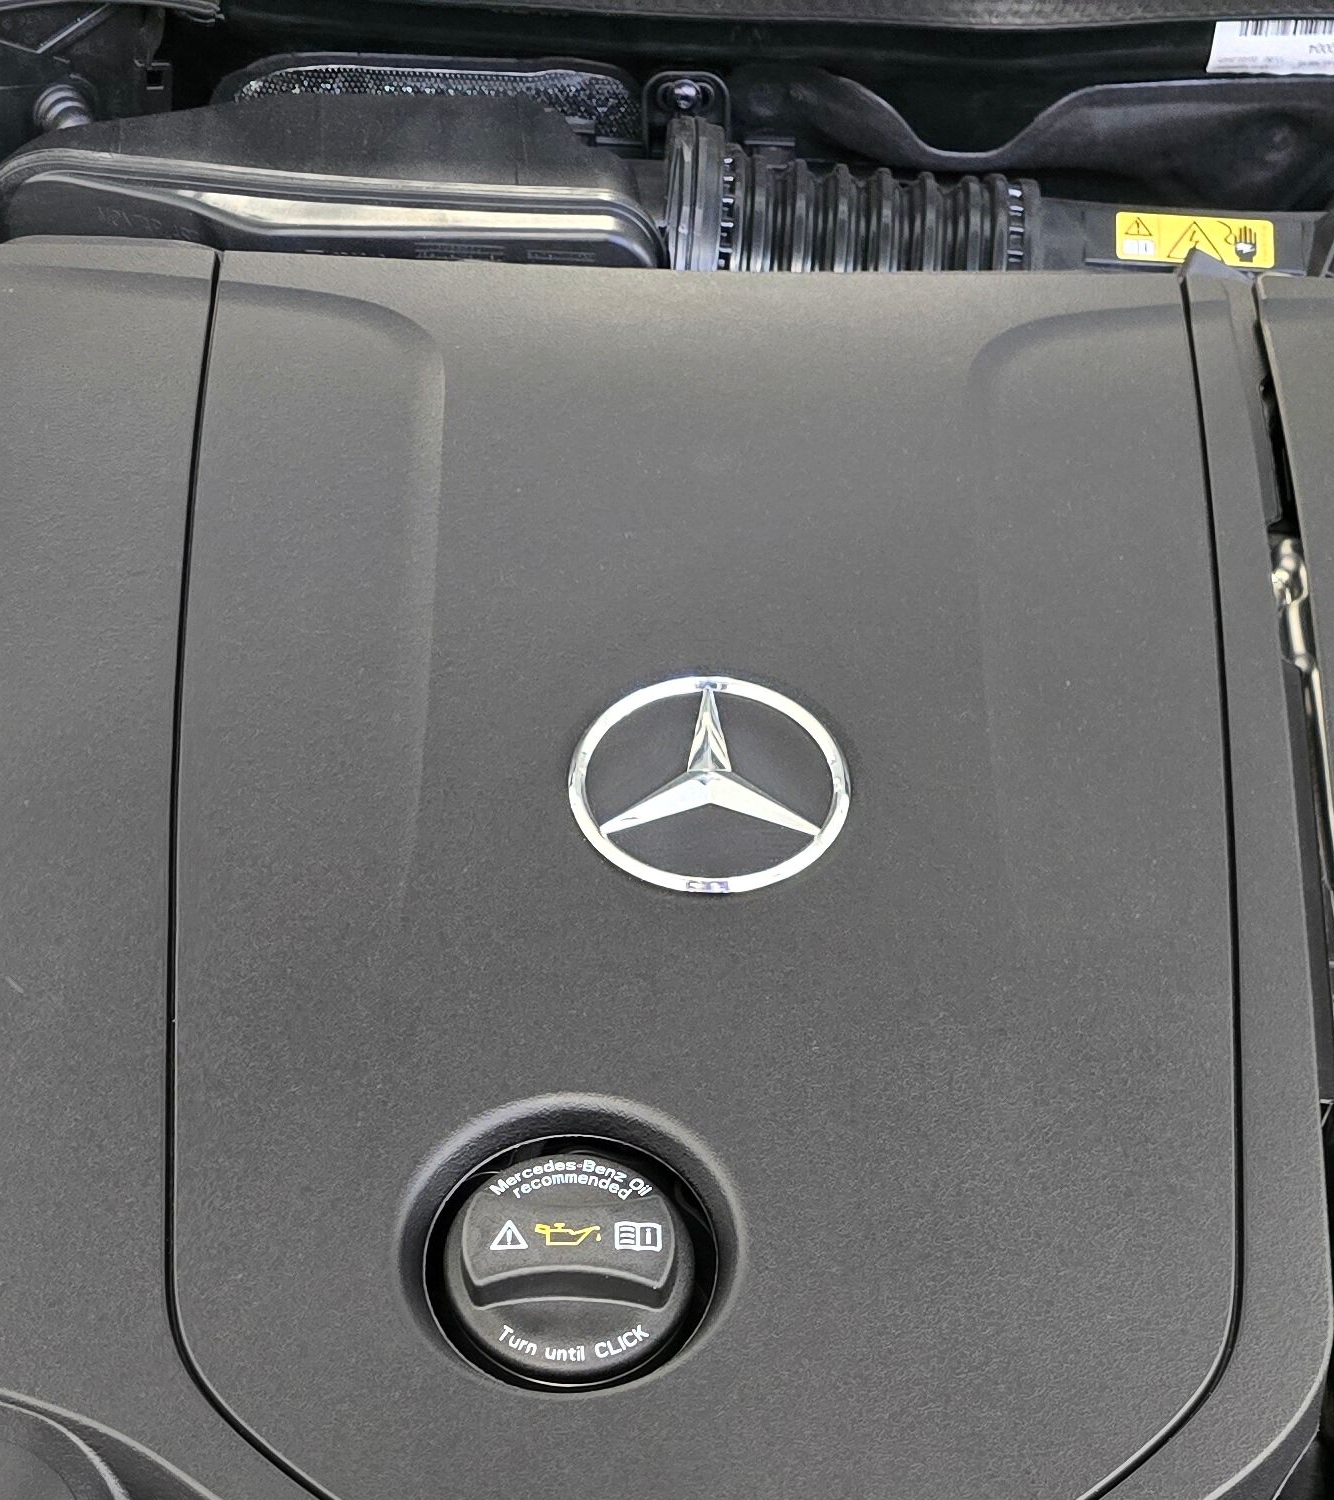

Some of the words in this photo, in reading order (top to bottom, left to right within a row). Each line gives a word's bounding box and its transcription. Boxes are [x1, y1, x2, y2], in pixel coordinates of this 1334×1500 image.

[489, 1159, 629, 1197] Mercedes-Benz
[629, 1177, 653, 1198] Oil
[513, 1171, 633, 1201] recommended
[498, 1324, 538, 1357] Turn
[545, 1345, 586, 1362] until
[594, 1324, 650, 1359] CLICK
